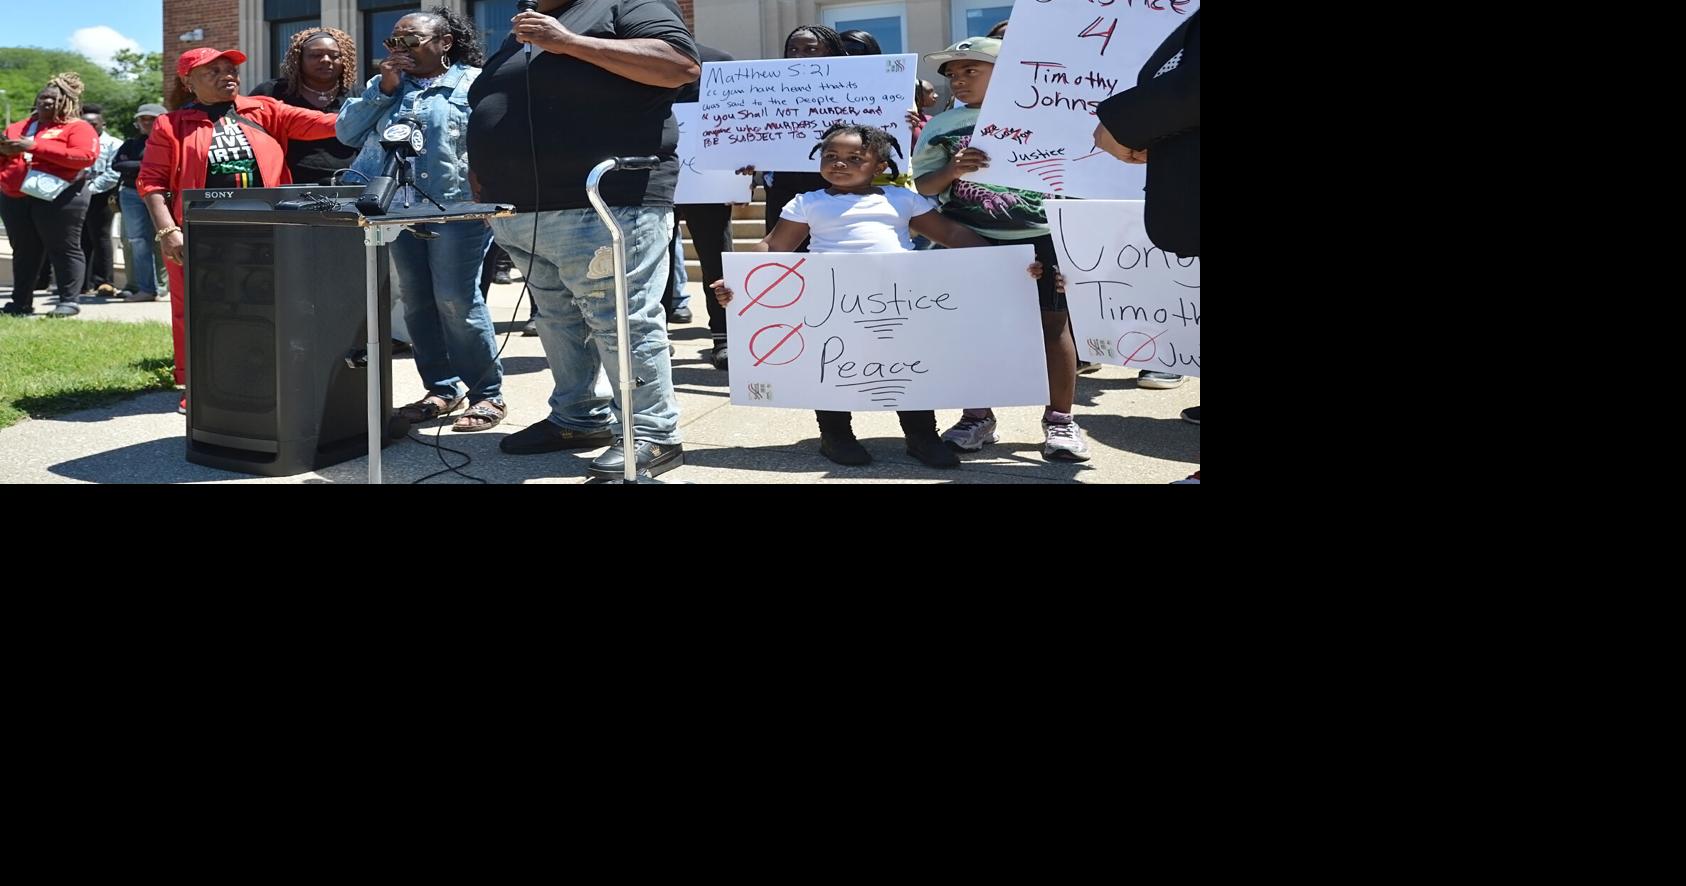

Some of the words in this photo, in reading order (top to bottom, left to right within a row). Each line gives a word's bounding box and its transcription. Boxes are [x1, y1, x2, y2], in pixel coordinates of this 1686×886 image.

[1078, 16, 1118, 56] 4
[706, 67, 781, 88] Matthew
[1020, 61, 1119, 95] Timothy
[749, 84, 775, 95] have
[702, 103, 721, 111] was
[727, 99, 745, 108] said
[768, 97, 787, 105] the
[795, 95, 838, 106] people
[776, 107, 800, 118] NOT
[862, 105, 883, 116] and
[703, 137, 719, 148] BE
[728, 131, 784, 144] SUBJECT
[787, 131, 807, 140] TO
[1007, 147, 1065, 163] Justice
[204, 191, 235, 199] SONY
[804, 268, 957, 328] Justice
[820, 335, 929, 383] Peace
